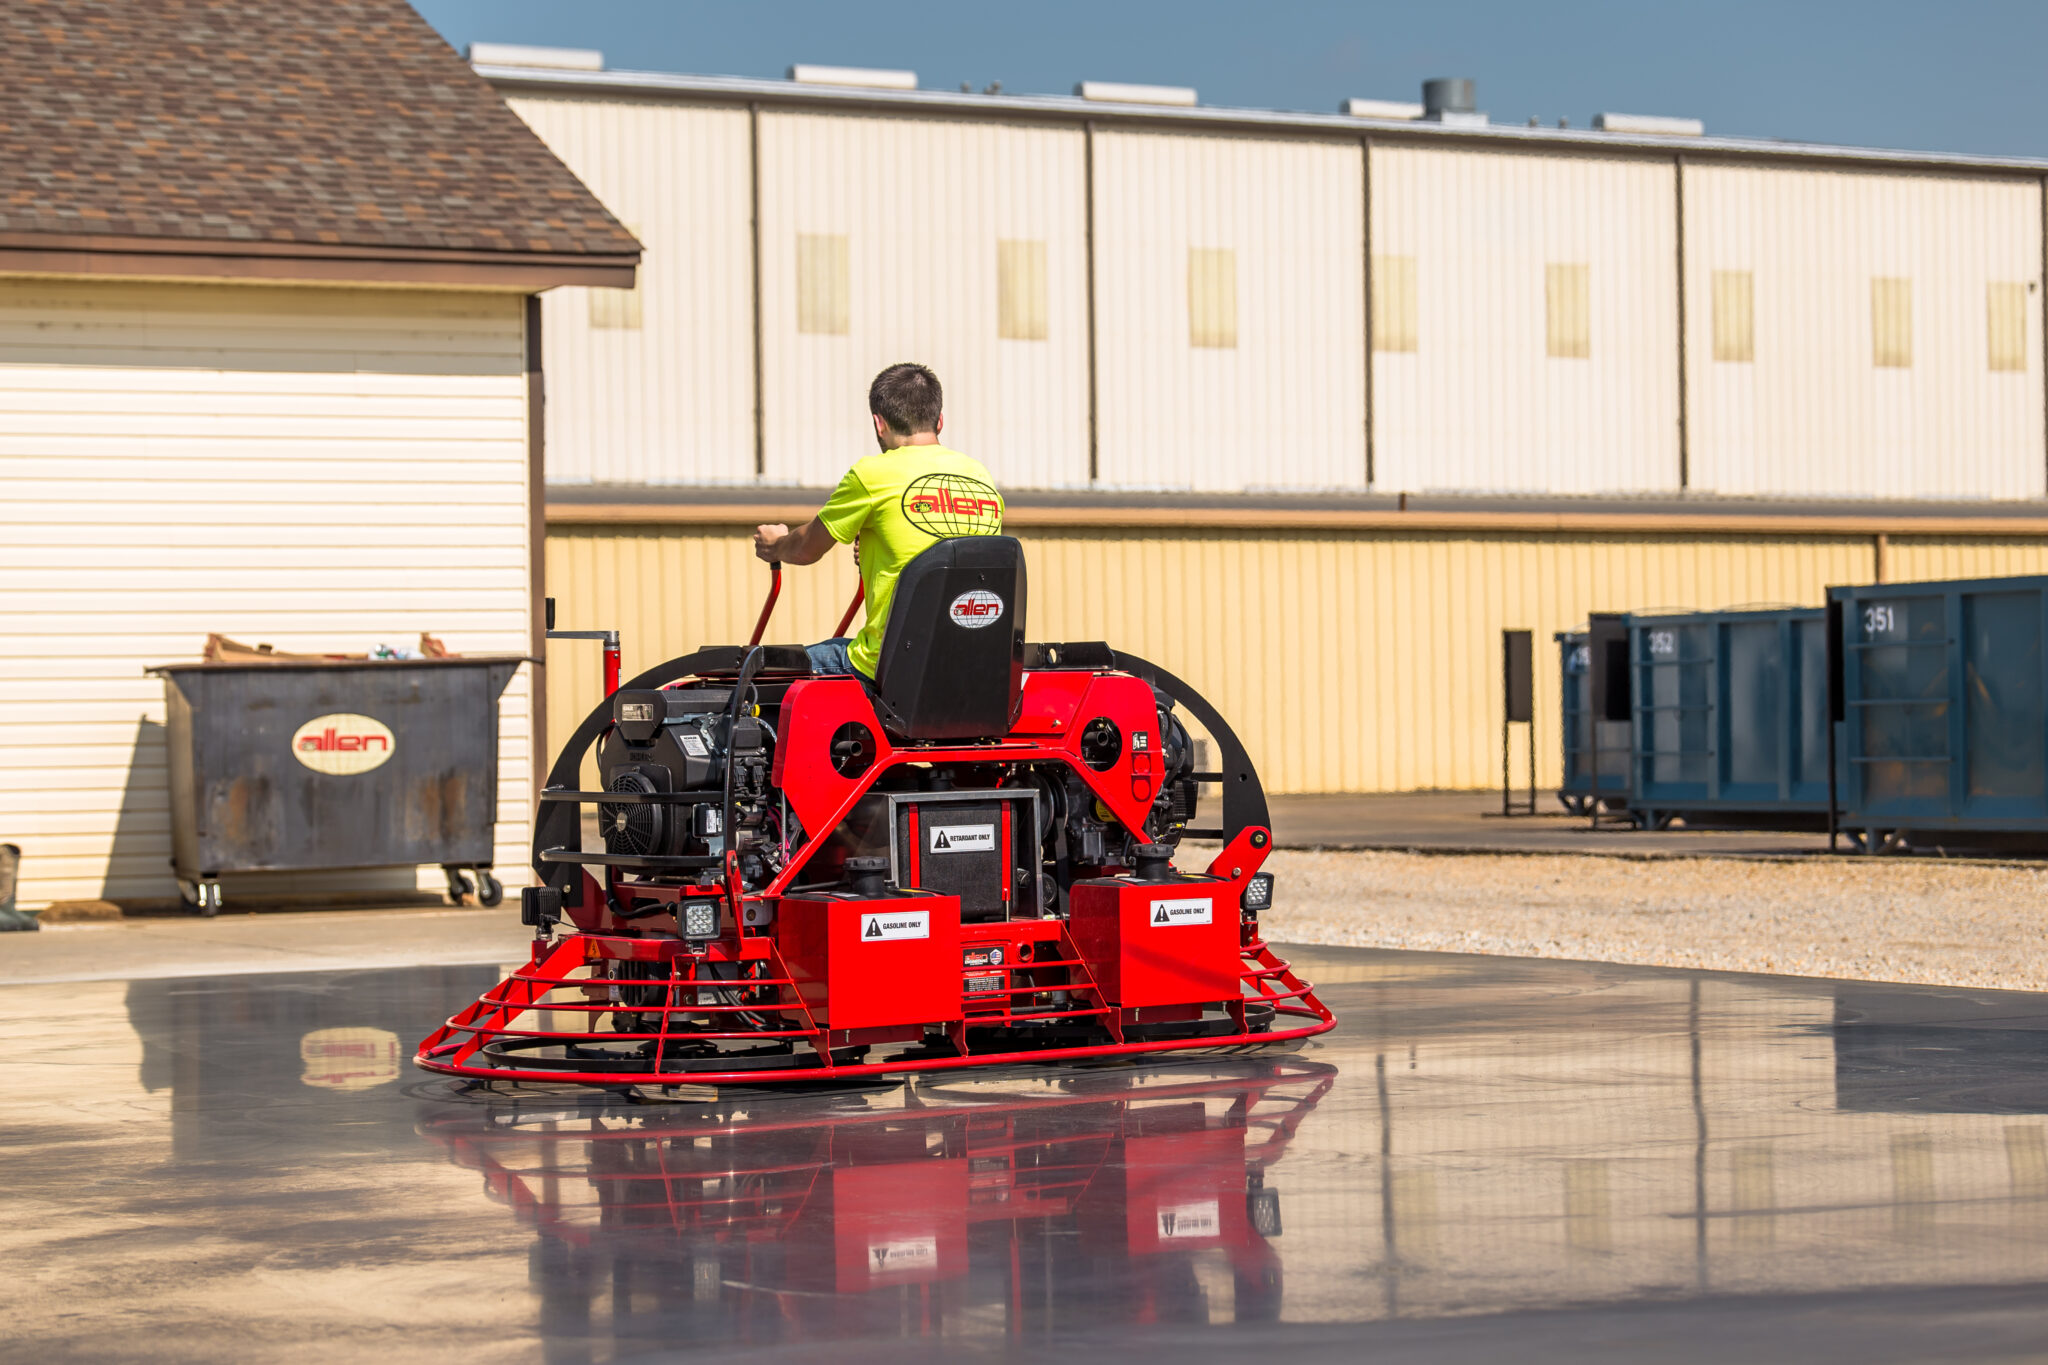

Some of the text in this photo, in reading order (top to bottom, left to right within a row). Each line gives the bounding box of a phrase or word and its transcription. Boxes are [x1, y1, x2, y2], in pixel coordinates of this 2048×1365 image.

[910, 488, 999, 519] allen
[953, 598, 1000, 616] allen
[1865, 606, 1894, 632] 351
[298, 728, 387, 751] allen
[950, 834, 977, 842] RETARDANT
